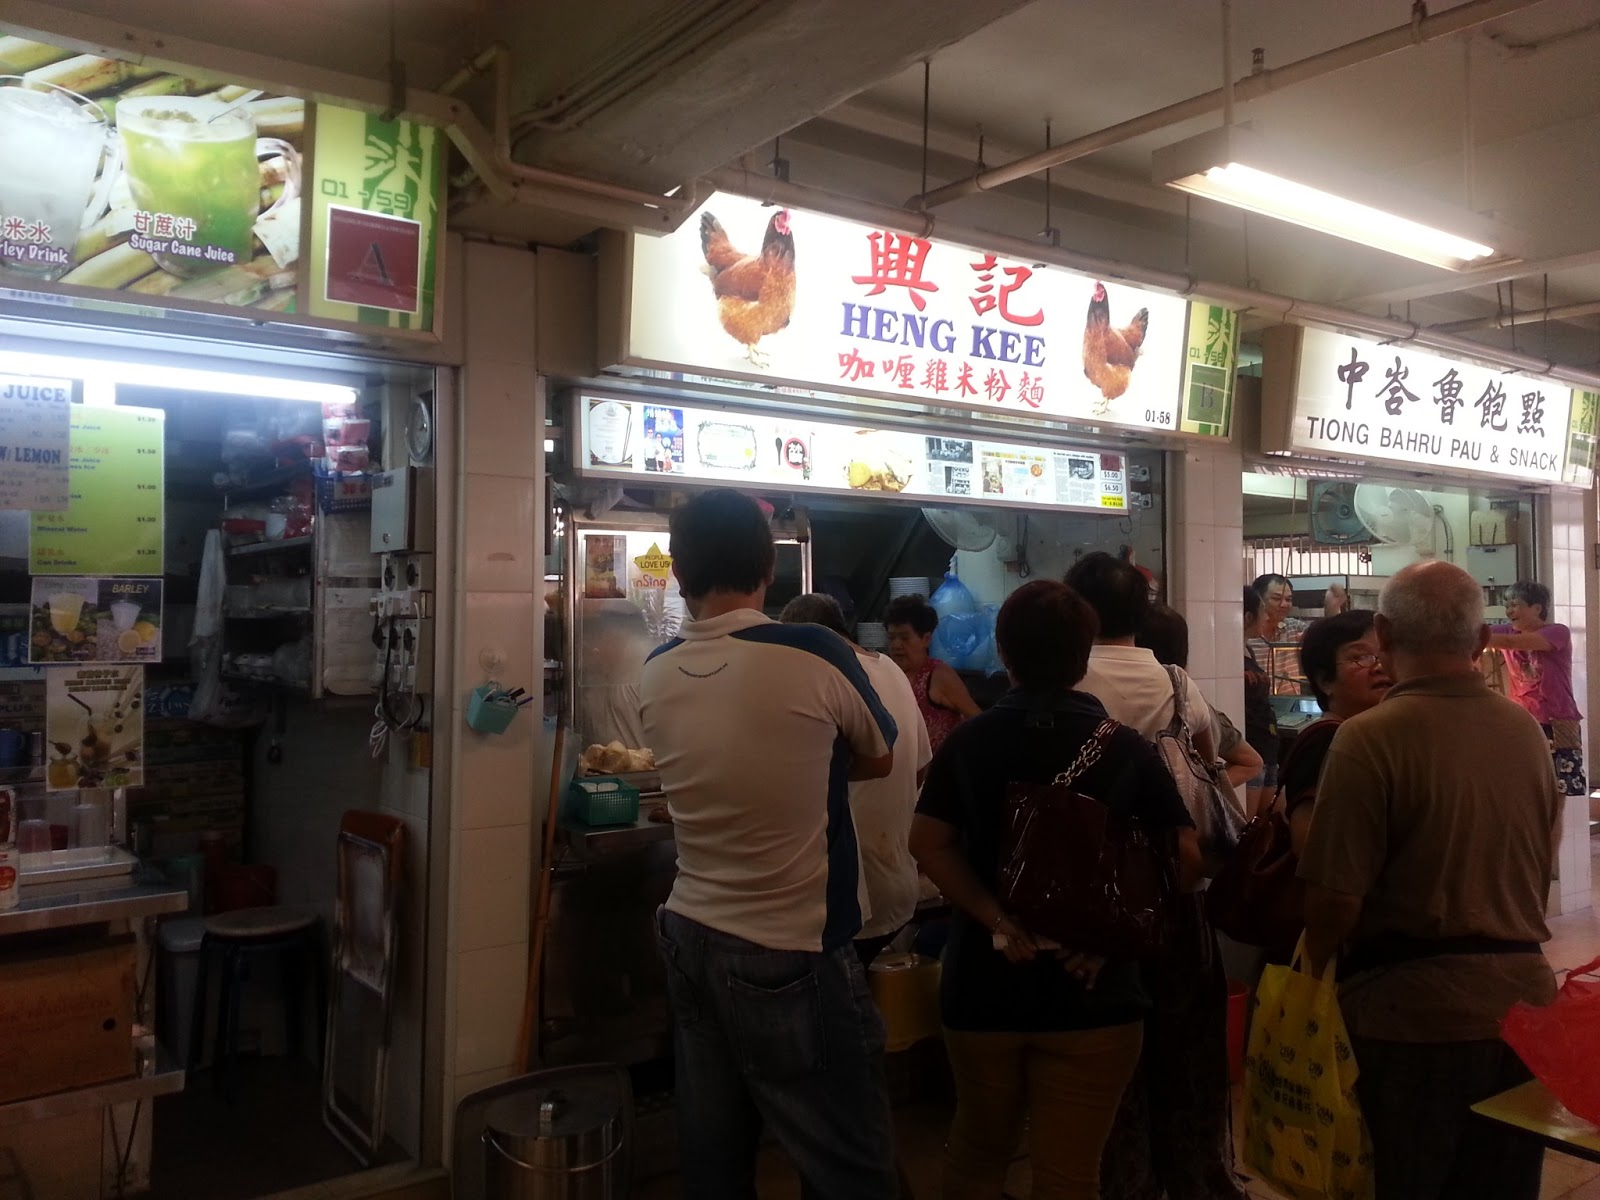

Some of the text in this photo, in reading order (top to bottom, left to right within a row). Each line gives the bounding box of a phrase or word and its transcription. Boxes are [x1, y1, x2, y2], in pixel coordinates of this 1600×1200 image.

[0, 215, 52, 244] 米水
[134, 211, 196, 240] 甘蔗汁
[29, 245, 68, 264] Drink
[130, 234, 234, 262] Sugar Cane Juice
[840, 302, 1047, 368] HENG KEE
[3, 384, 66, 402] JUICE
[15, 446, 61, 464] LEMON
[1306, 416, 1558, 472] TIONG BAHRU PAU & SNACK
[640, 561, 658, 569] LOVE
[111, 584, 149, 594] BARLEY
